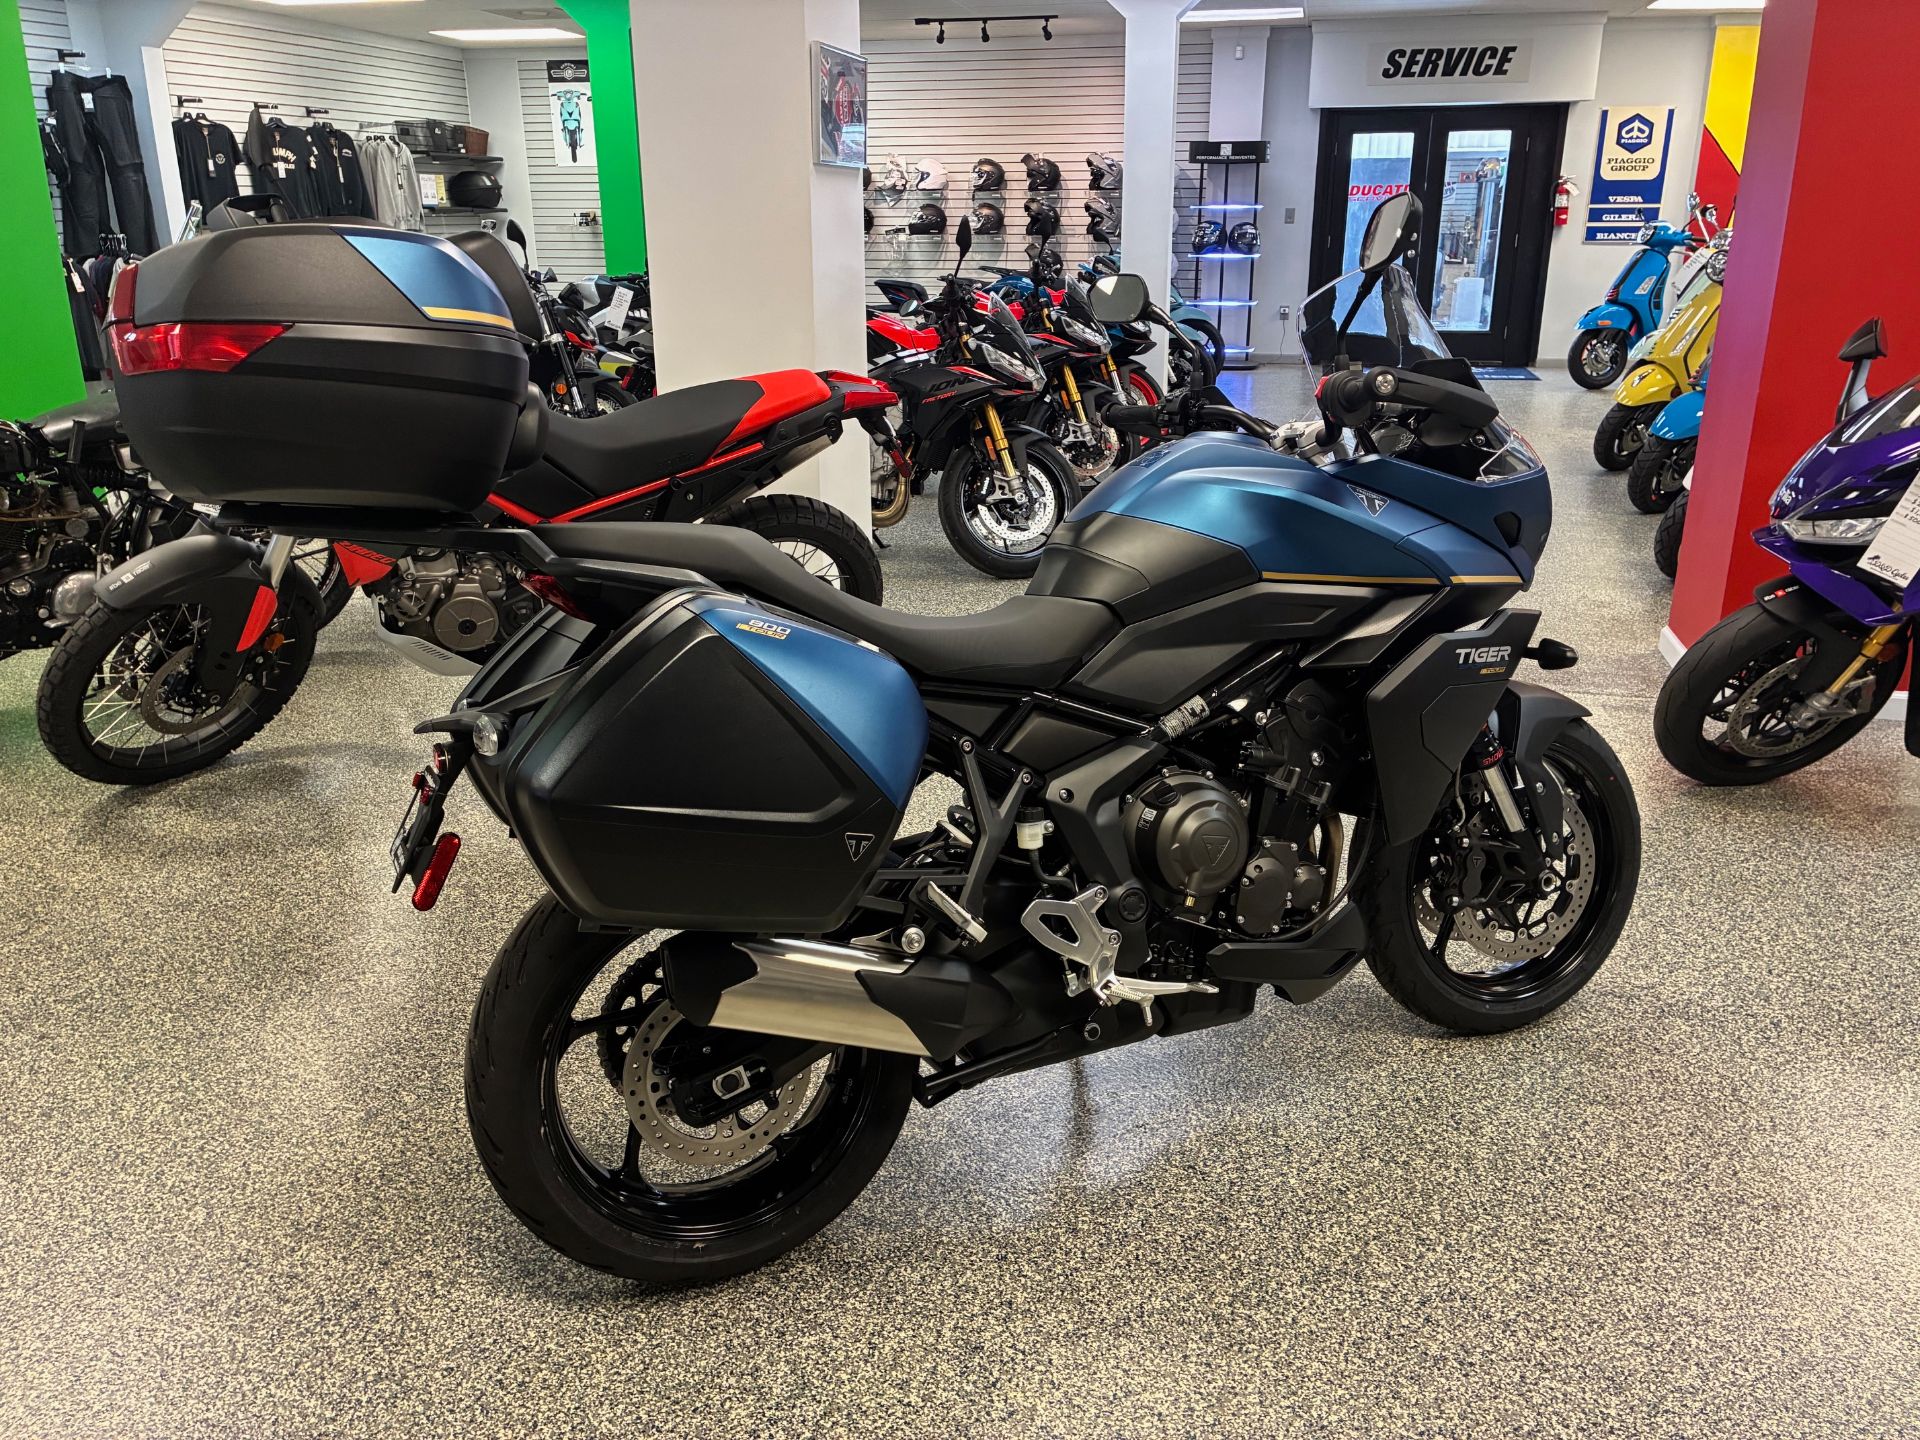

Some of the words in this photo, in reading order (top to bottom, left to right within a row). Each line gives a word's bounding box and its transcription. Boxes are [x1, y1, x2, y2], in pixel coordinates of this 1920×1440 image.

[1381, 46, 1518, 78] SERVICE
[1607, 157, 1655, 165] PIAGGIO
[1608, 195, 1644, 203] VESPA
[749, 619, 791, 634] 800
[1455, 645, 1512, 665] TIGER
